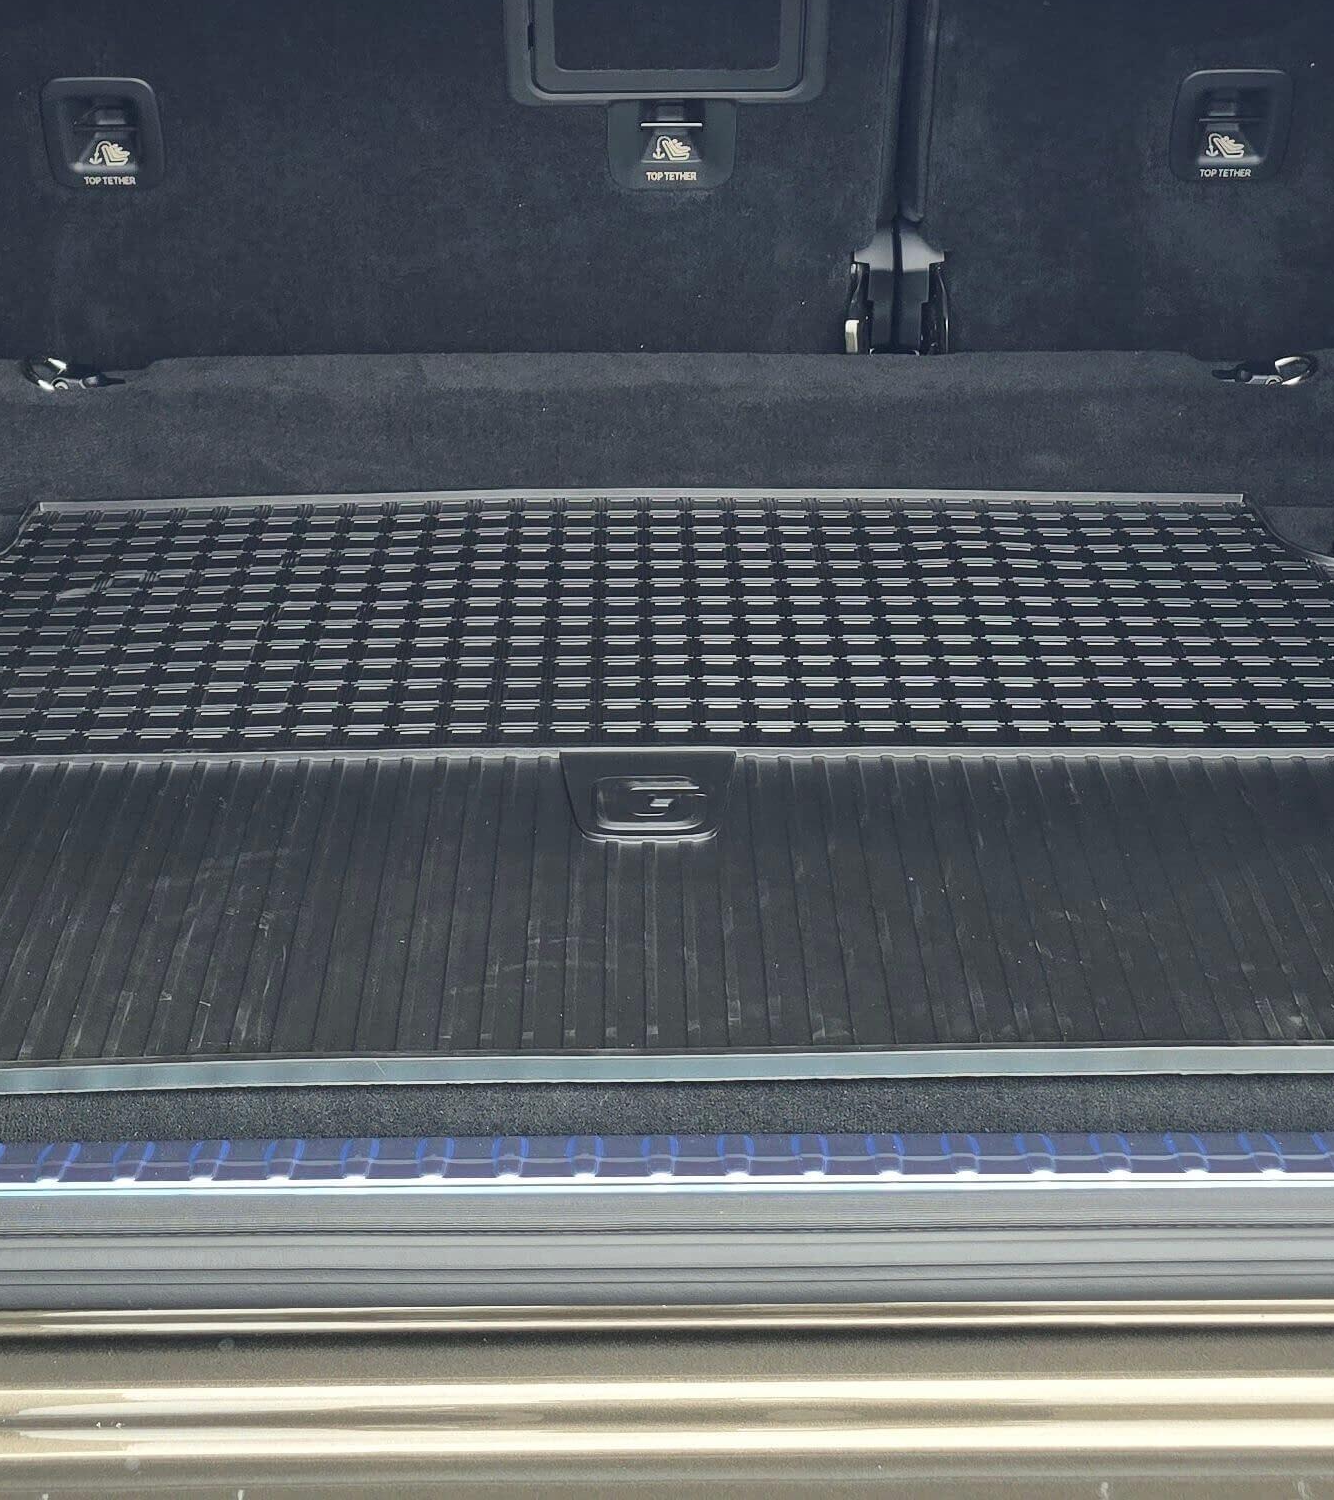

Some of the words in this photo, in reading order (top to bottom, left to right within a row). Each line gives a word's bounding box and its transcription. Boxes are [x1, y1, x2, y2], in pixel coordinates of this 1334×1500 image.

[645, 171, 664, 181] TOP
[665, 171, 697, 181] TETHER
[1199, 168, 1217, 178] TOP
[1218, 168, 1252, 178] TETHER
[83, 176, 101, 185] TOP
[103, 176, 136, 185] TETHER
